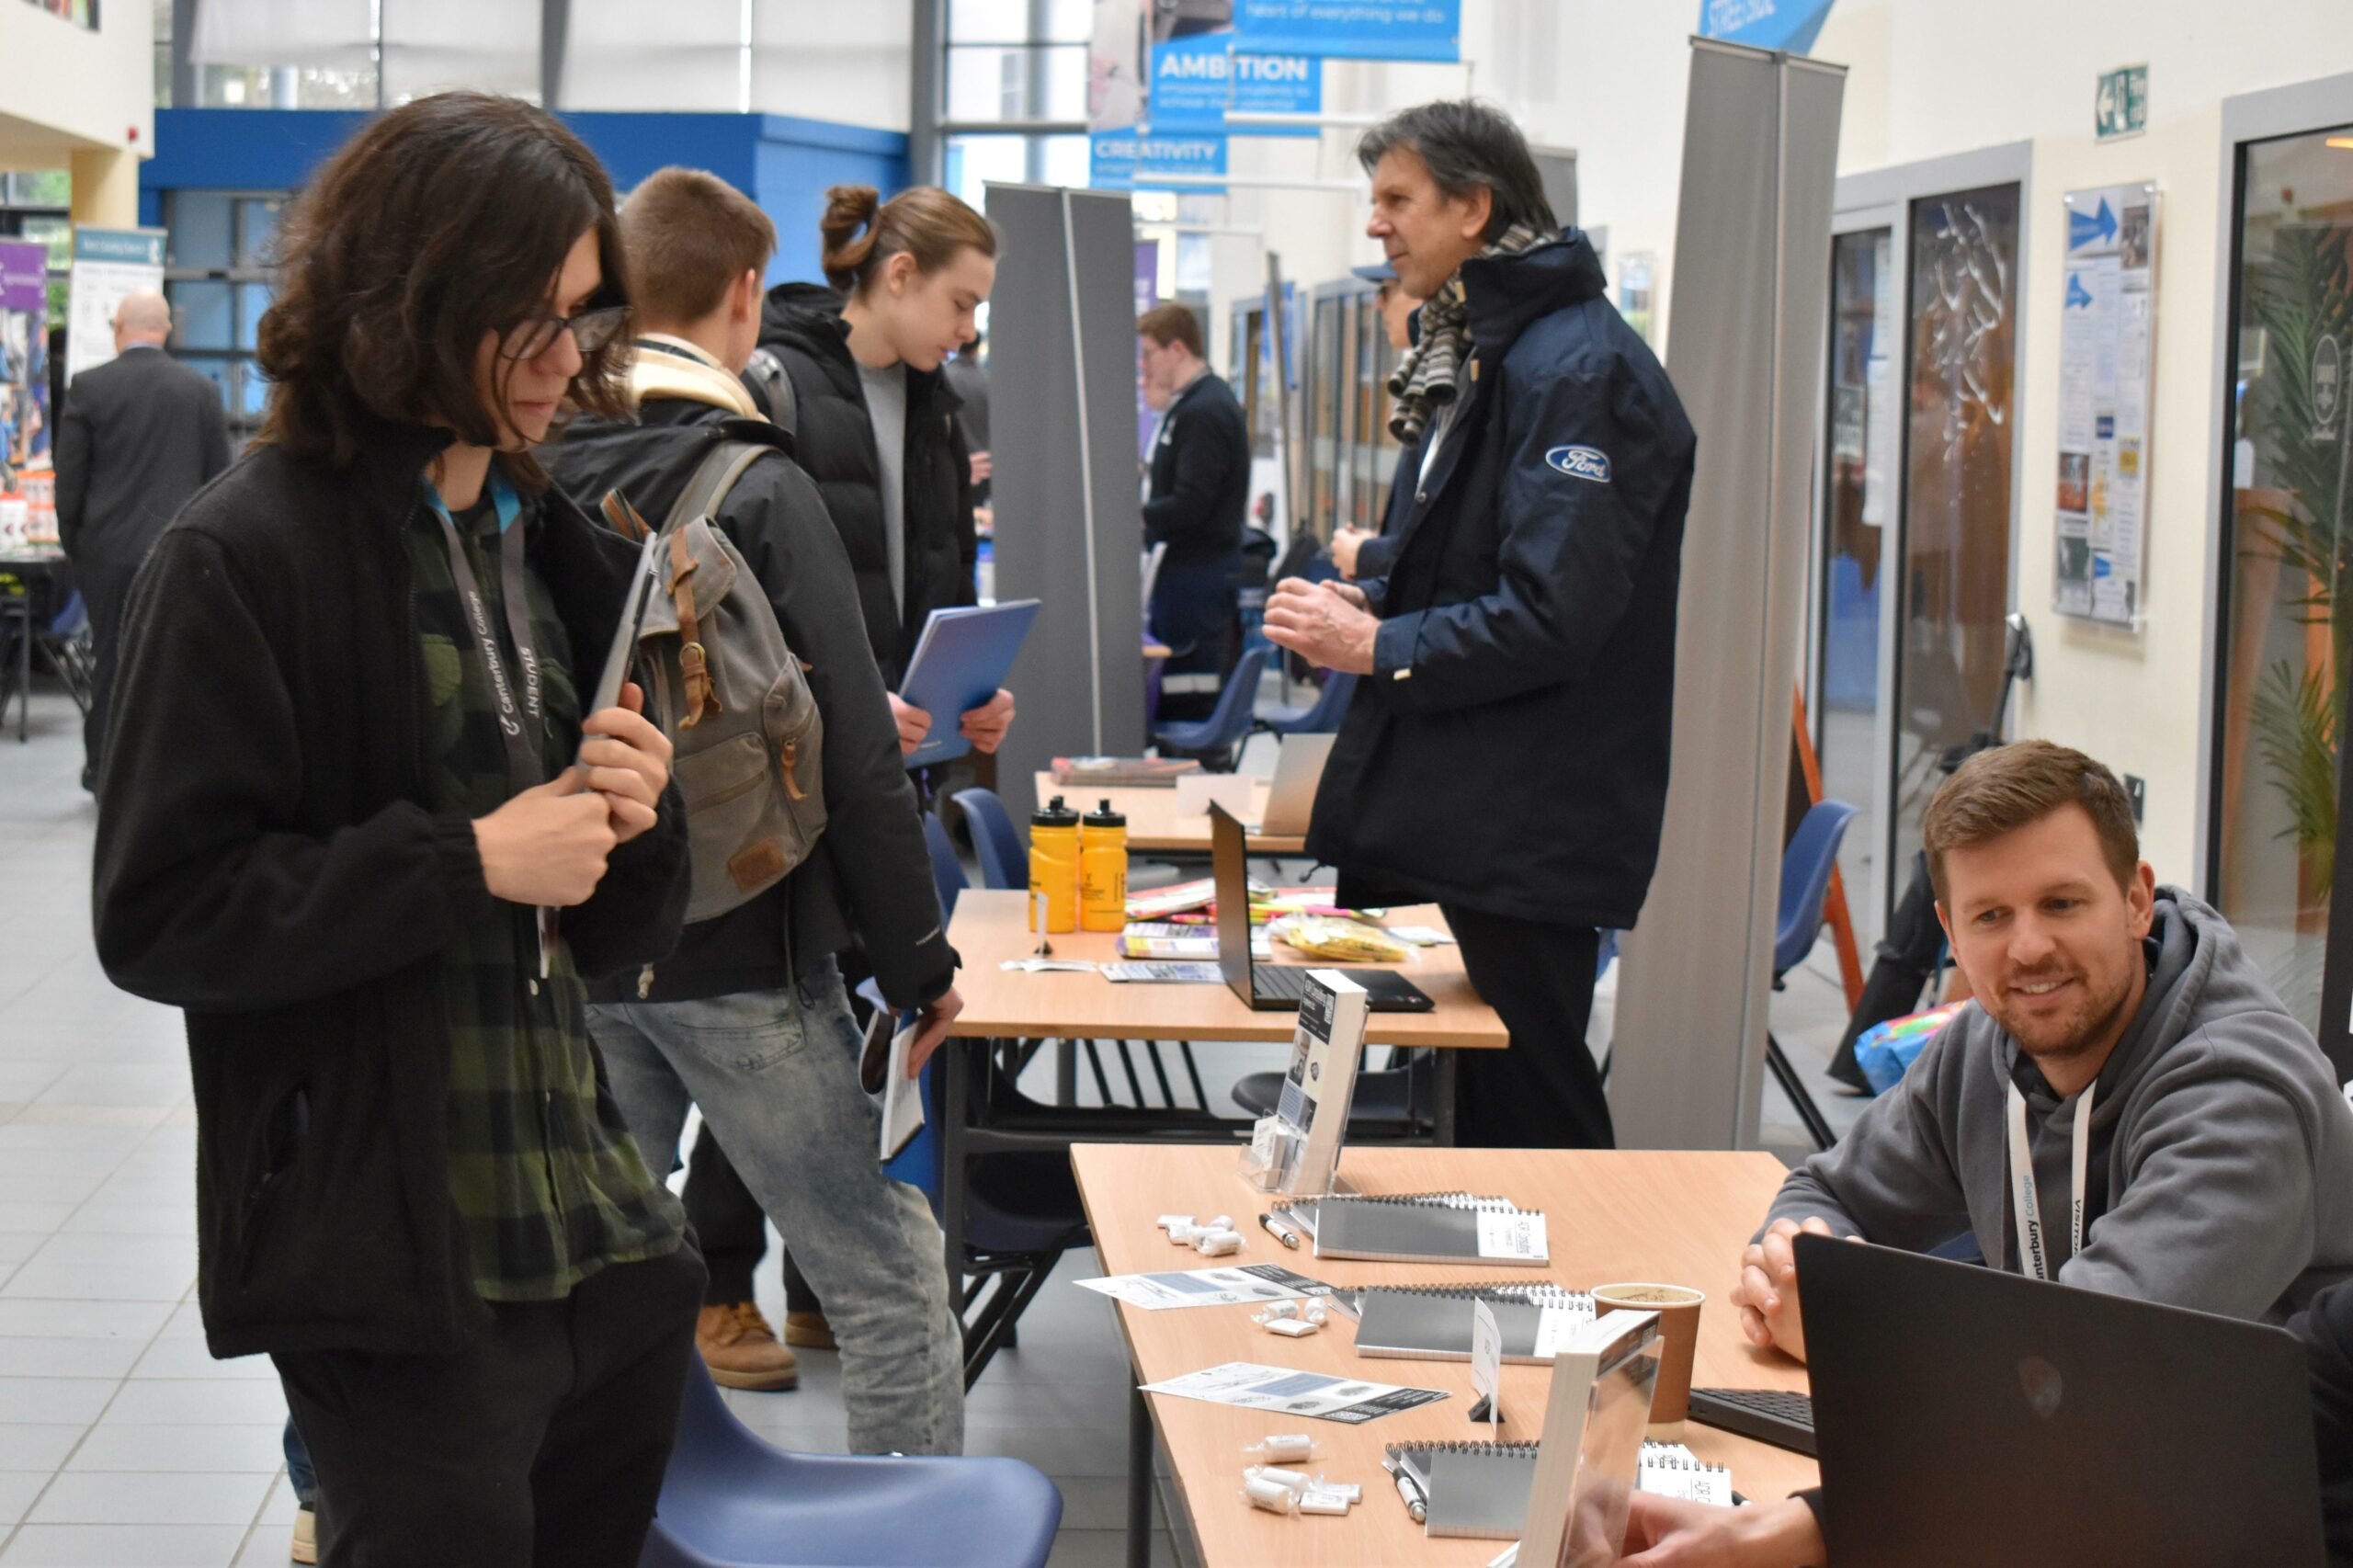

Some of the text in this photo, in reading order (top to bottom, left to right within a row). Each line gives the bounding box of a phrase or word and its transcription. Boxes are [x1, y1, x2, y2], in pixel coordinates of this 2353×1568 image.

[1159, 52, 1308, 81] AMBTION
[1095, 140, 1218, 160] CREATIVITY
[1562, 450, 1605, 477] Ford
[468, 591, 514, 713] Canterbury College
[519, 647, 540, 718] STUDENT
[2023, 1176, 2044, 1280] nterbury College
